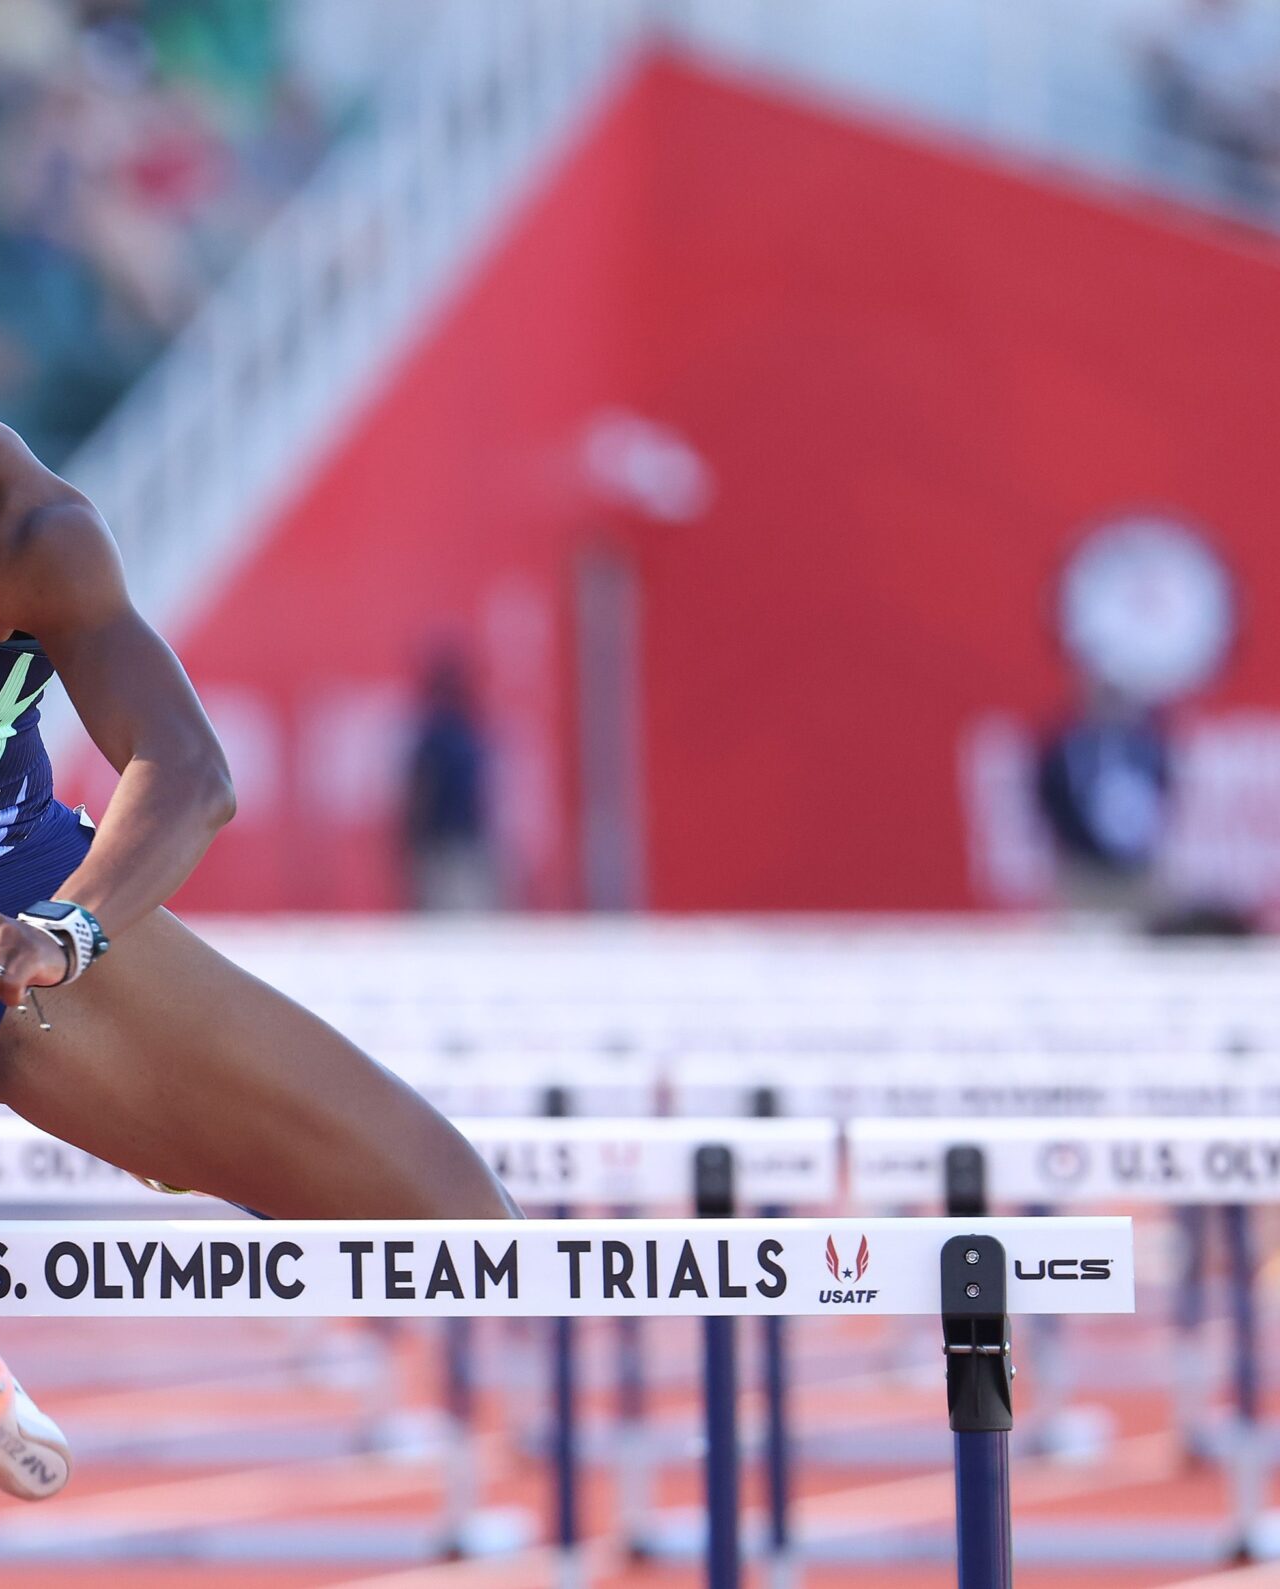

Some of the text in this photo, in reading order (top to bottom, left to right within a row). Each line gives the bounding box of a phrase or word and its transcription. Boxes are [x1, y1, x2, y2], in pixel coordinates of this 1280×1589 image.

[45, 1241, 305, 1300] OLYMPIC
[340, 1240, 518, 1299] TEAM
[558, 1239, 787, 1299] TRIALS
[1015, 1259, 1114, 1281] UCS
[819, 1290, 878, 1304] USATF
